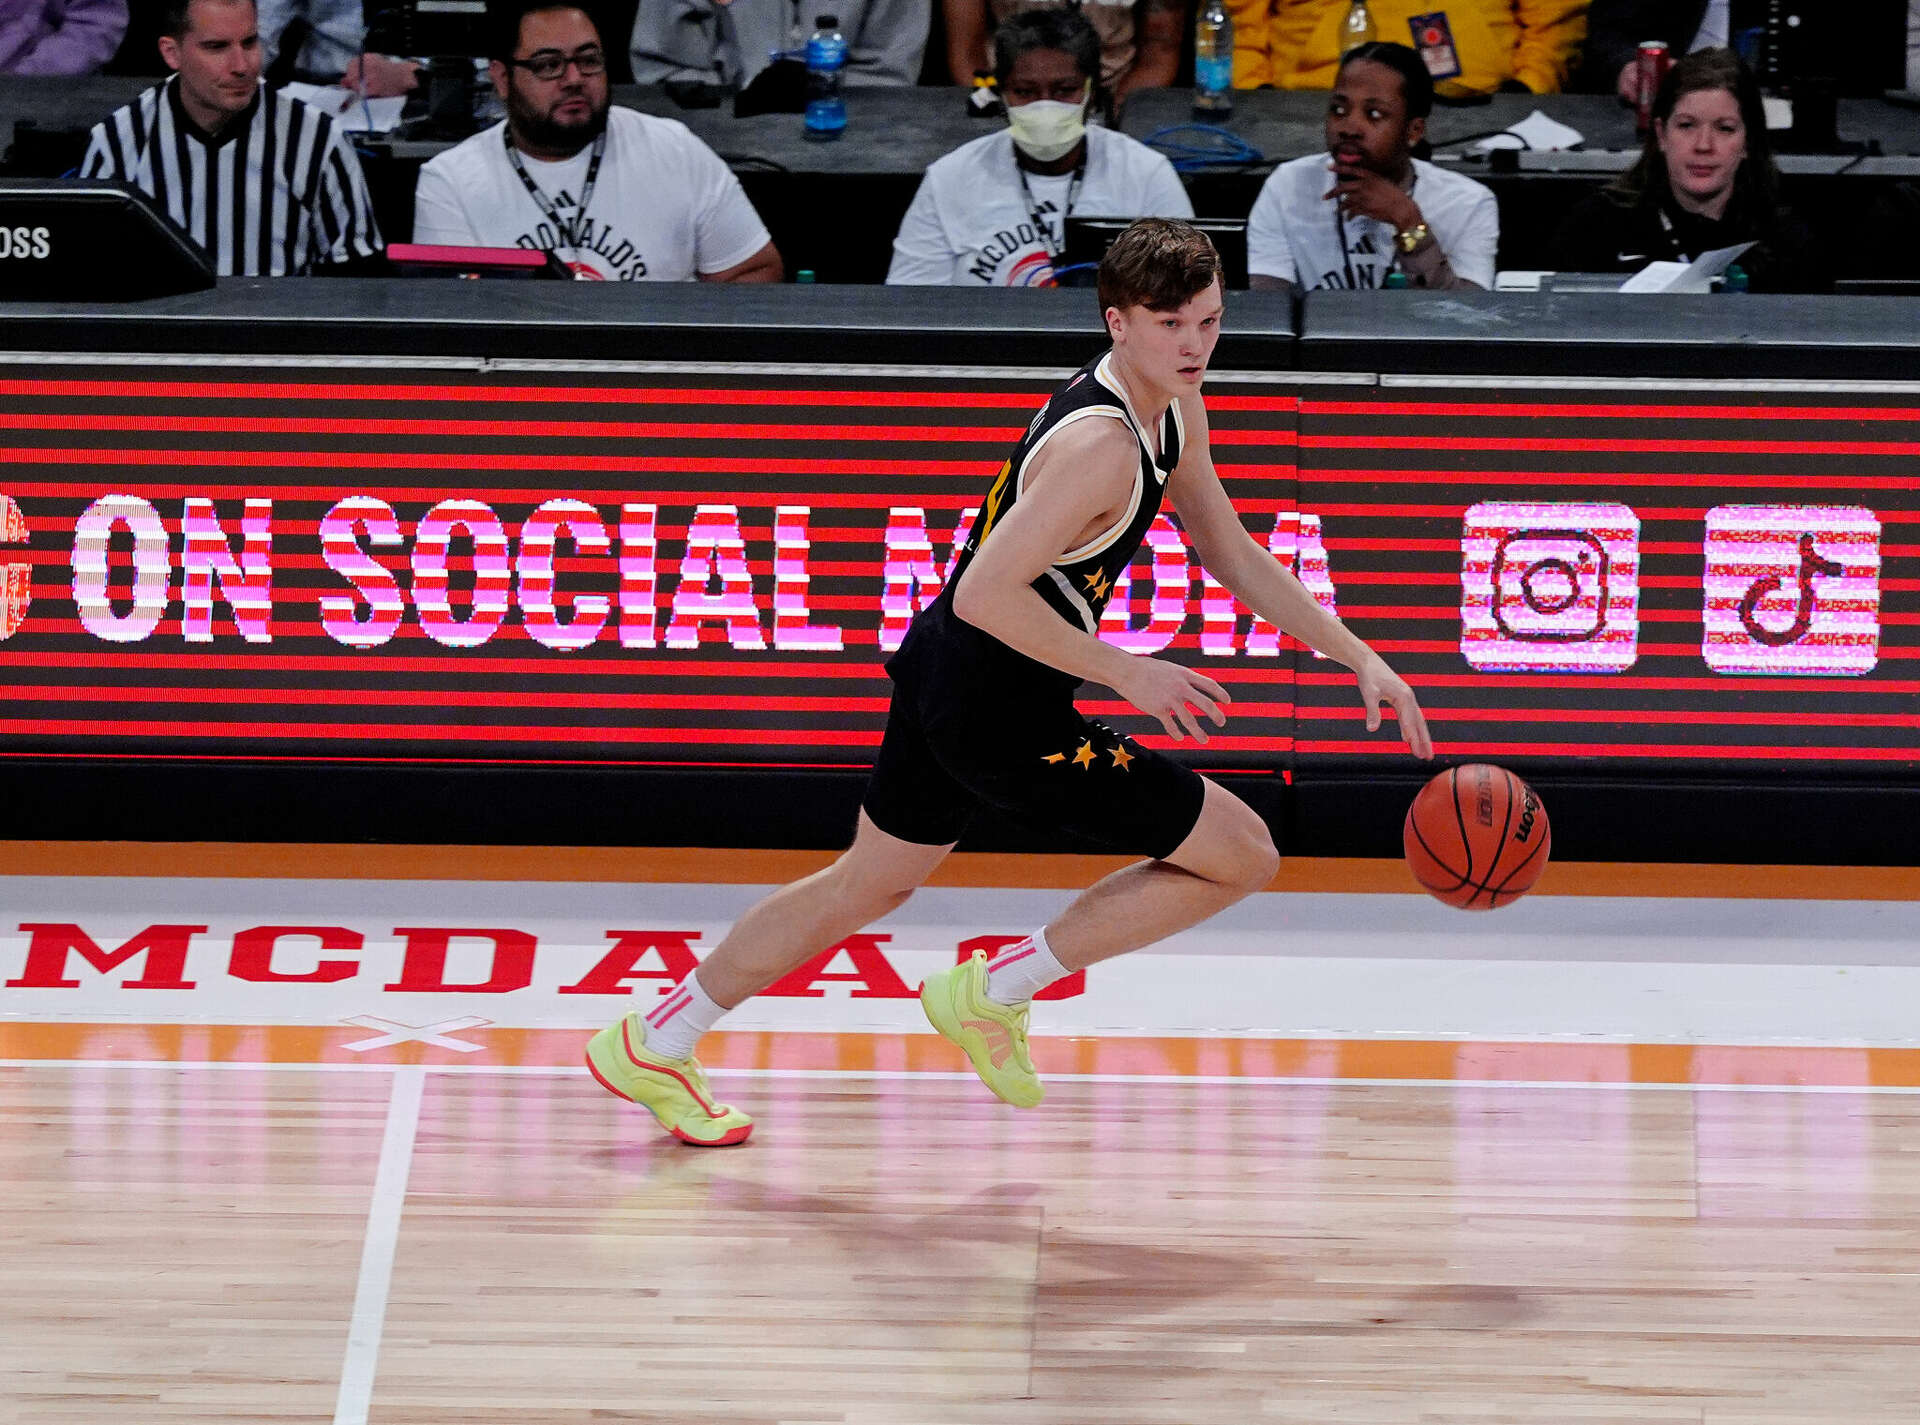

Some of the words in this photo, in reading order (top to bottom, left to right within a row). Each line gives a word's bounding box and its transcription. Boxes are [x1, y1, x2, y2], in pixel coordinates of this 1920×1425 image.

[72, 494, 272, 643] ON
[318, 495, 844, 652] SOCIAL
[879, 507, 1343, 660] MDIA
